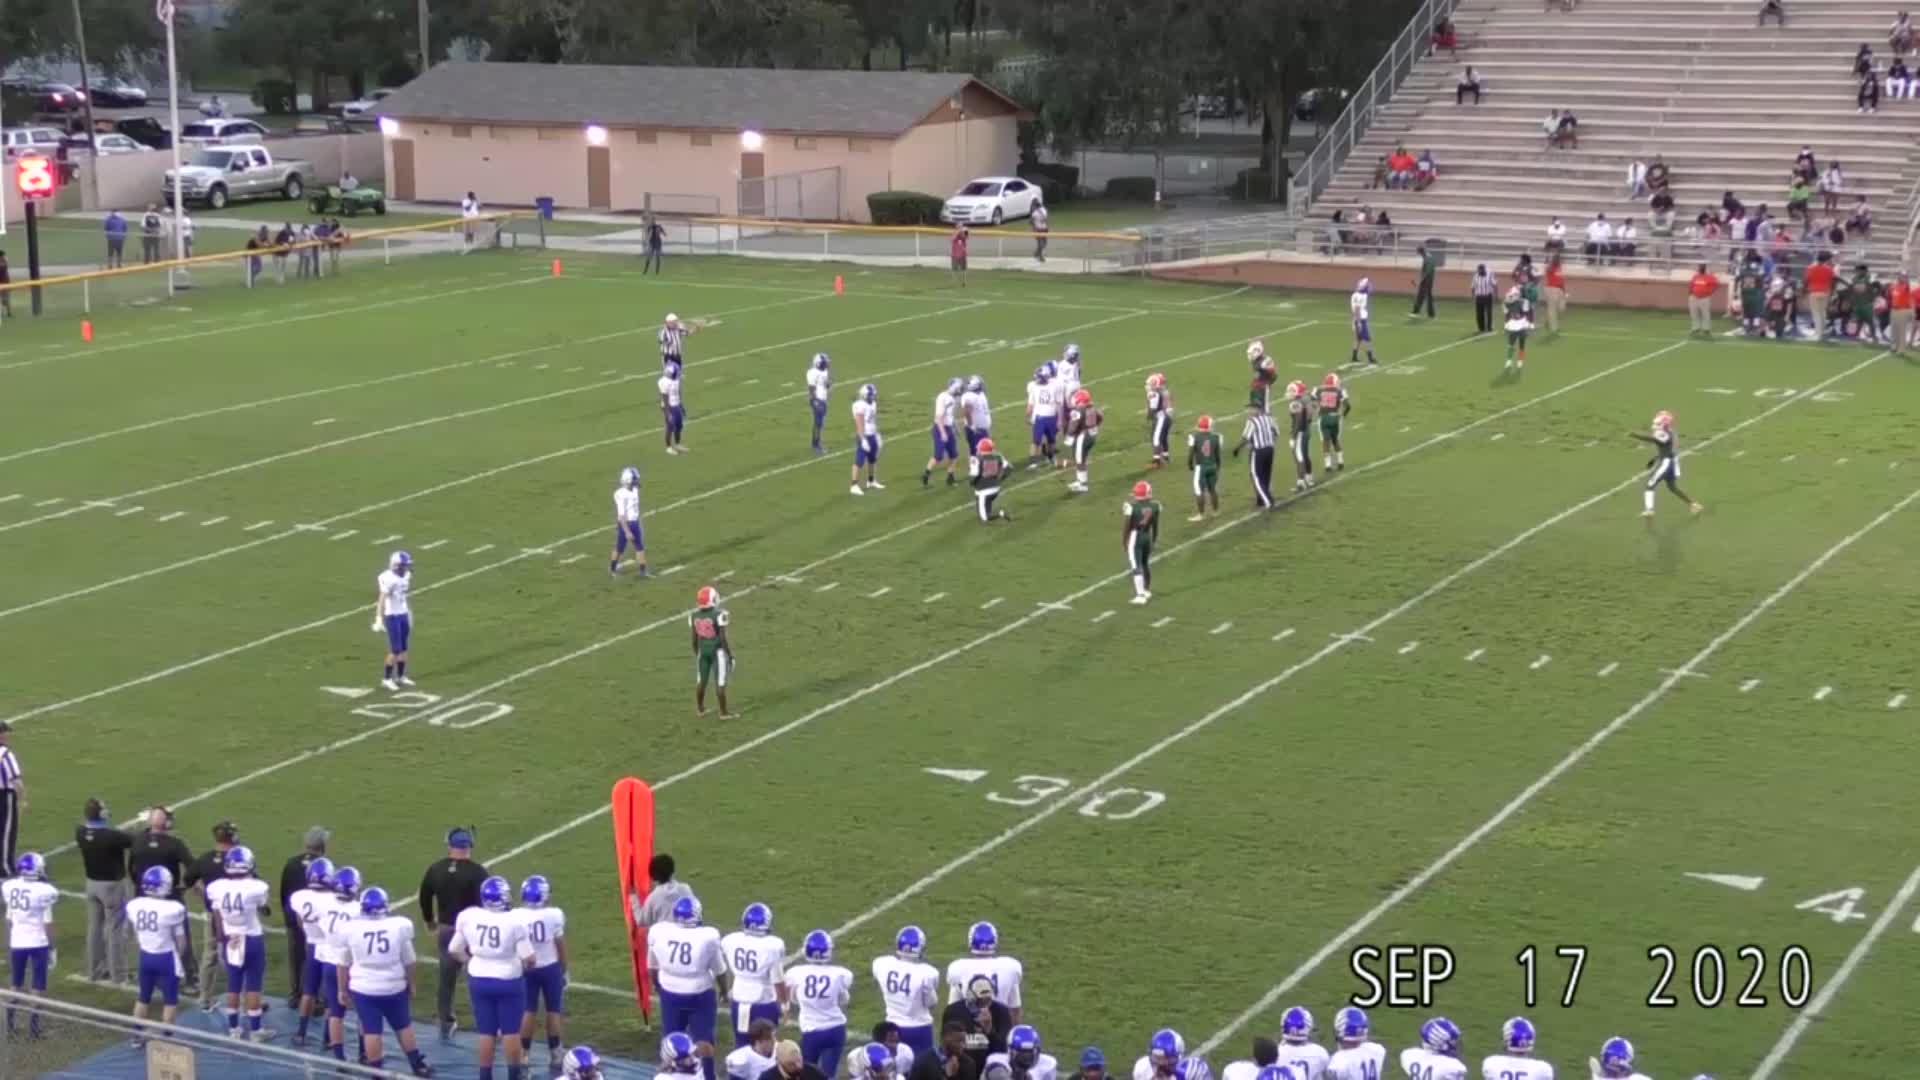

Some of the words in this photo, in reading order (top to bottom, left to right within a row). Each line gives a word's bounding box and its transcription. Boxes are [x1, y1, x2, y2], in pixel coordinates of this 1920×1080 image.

[985, 775, 1165, 820] 30
[10, 888, 31, 912] 85
[222, 892, 244, 913] 44
[136, 909, 159, 932] 88
[363, 930, 390, 955] 75
[476, 924, 500, 949] 79
[668, 940, 692, 966] 78
[734, 947, 758, 973] 66
[804, 974, 831, 1000] 82
[887, 970, 911, 997] 64
